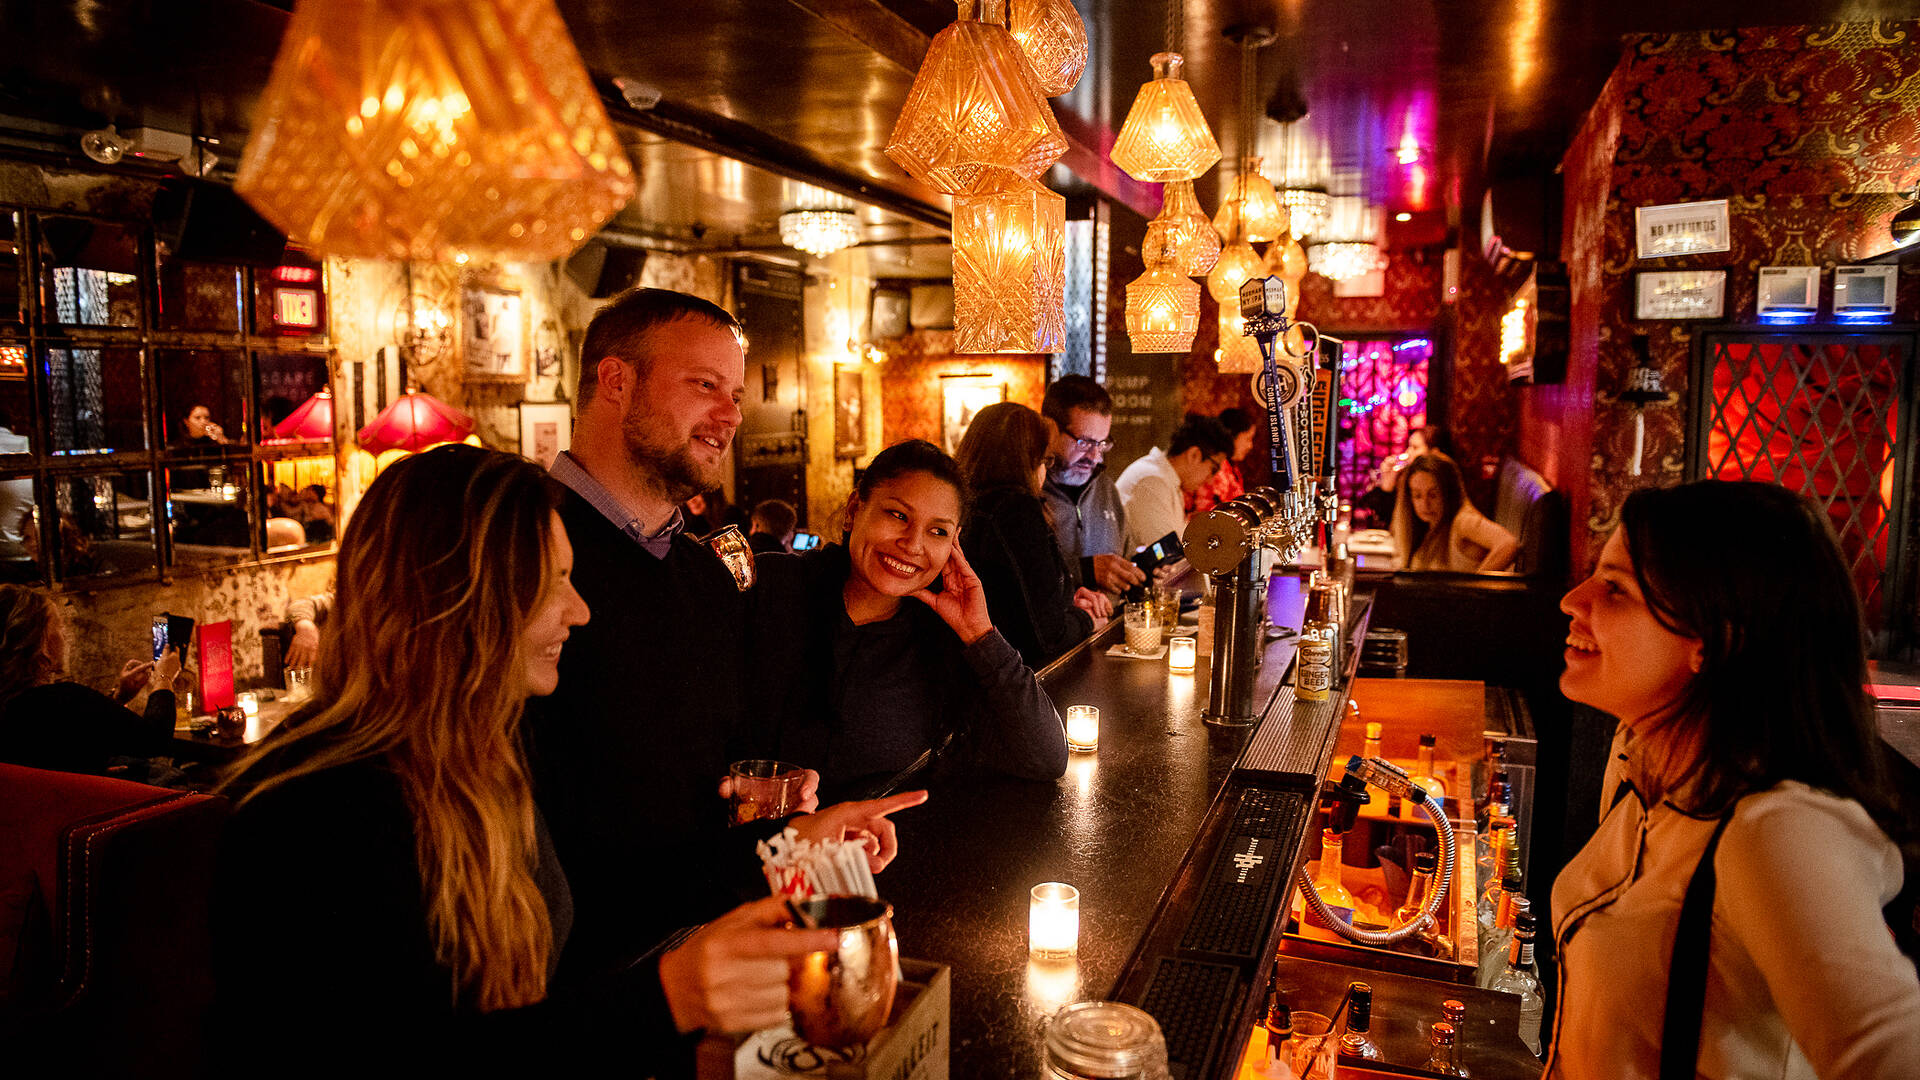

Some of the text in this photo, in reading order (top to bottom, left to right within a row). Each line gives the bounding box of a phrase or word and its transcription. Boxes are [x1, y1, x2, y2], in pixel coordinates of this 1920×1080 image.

[1109, 393, 1152, 408] OOM
[1267, 387, 1277, 412] CONEY
[1269, 414, 1280, 444] ISLAND
[1300, 402, 1310, 471] TWO ROADS
